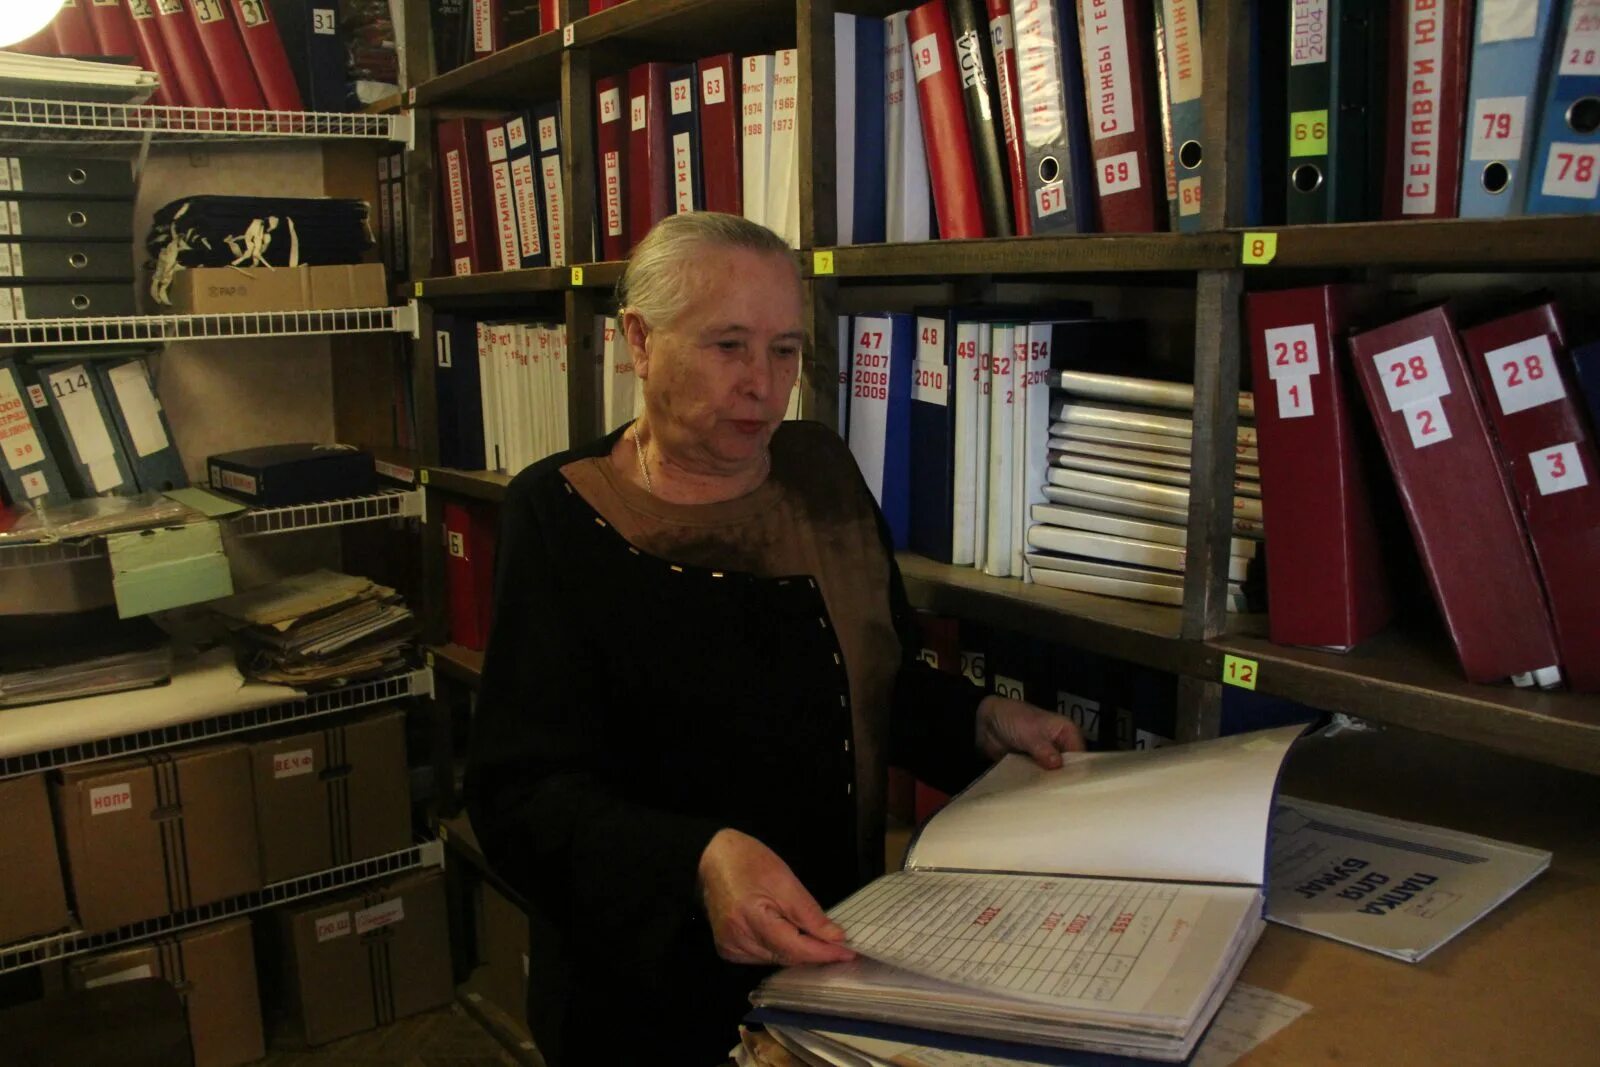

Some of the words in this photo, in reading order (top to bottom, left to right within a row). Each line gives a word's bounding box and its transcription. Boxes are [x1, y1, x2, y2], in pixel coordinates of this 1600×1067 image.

[314, 14, 335, 30] 31
[749, 57, 756, 73] 6
[783, 51, 790, 66] 5
[914, 48, 931, 69] 19
[674, 85, 686, 101] 62
[706, 79, 721, 95] 63
[1098, 45, 1118, 134] СЛУЖБЫ
[604, 100, 615, 114] 61
[1295, 122, 1326, 141] 66
[1406, 59, 1435, 198] СЕЛАВРИ
[1483, 113, 1512, 140] 79
[1104, 161, 1129, 185] 69
[1557, 153, 1595, 183] 78
[608, 176, 619, 229] ОРЛОВ
[1041, 188, 1061, 212] 67
[1252, 240, 1265, 258] 8
[860, 331, 883, 349] 47
[922, 327, 938, 345] 48
[440, 334, 449, 364] 1
[958, 341, 976, 359] 49
[1031, 342, 1048, 360] 54
[1274, 340, 1309, 366] 28
[855, 353, 889, 369] 2007
[992, 357, 1011, 375] 52
[1390, 355, 1429, 388] 28
[1502, 355, 1546, 388] 28
[53, 374, 89, 399] 114
[855, 370, 887, 386] 2008
[915, 369, 943, 390] 2010
[854, 385, 887, 400] 2009
[1288, 385, 1299, 408] 1
[1416, 410, 1437, 437] 2
[1546, 453, 1568, 479] 3
[1228, 661, 1253, 683] 12
[1336, 871, 1391, 901] ДЛЯ
[1356, 872, 1440, 917] ПАПКА
